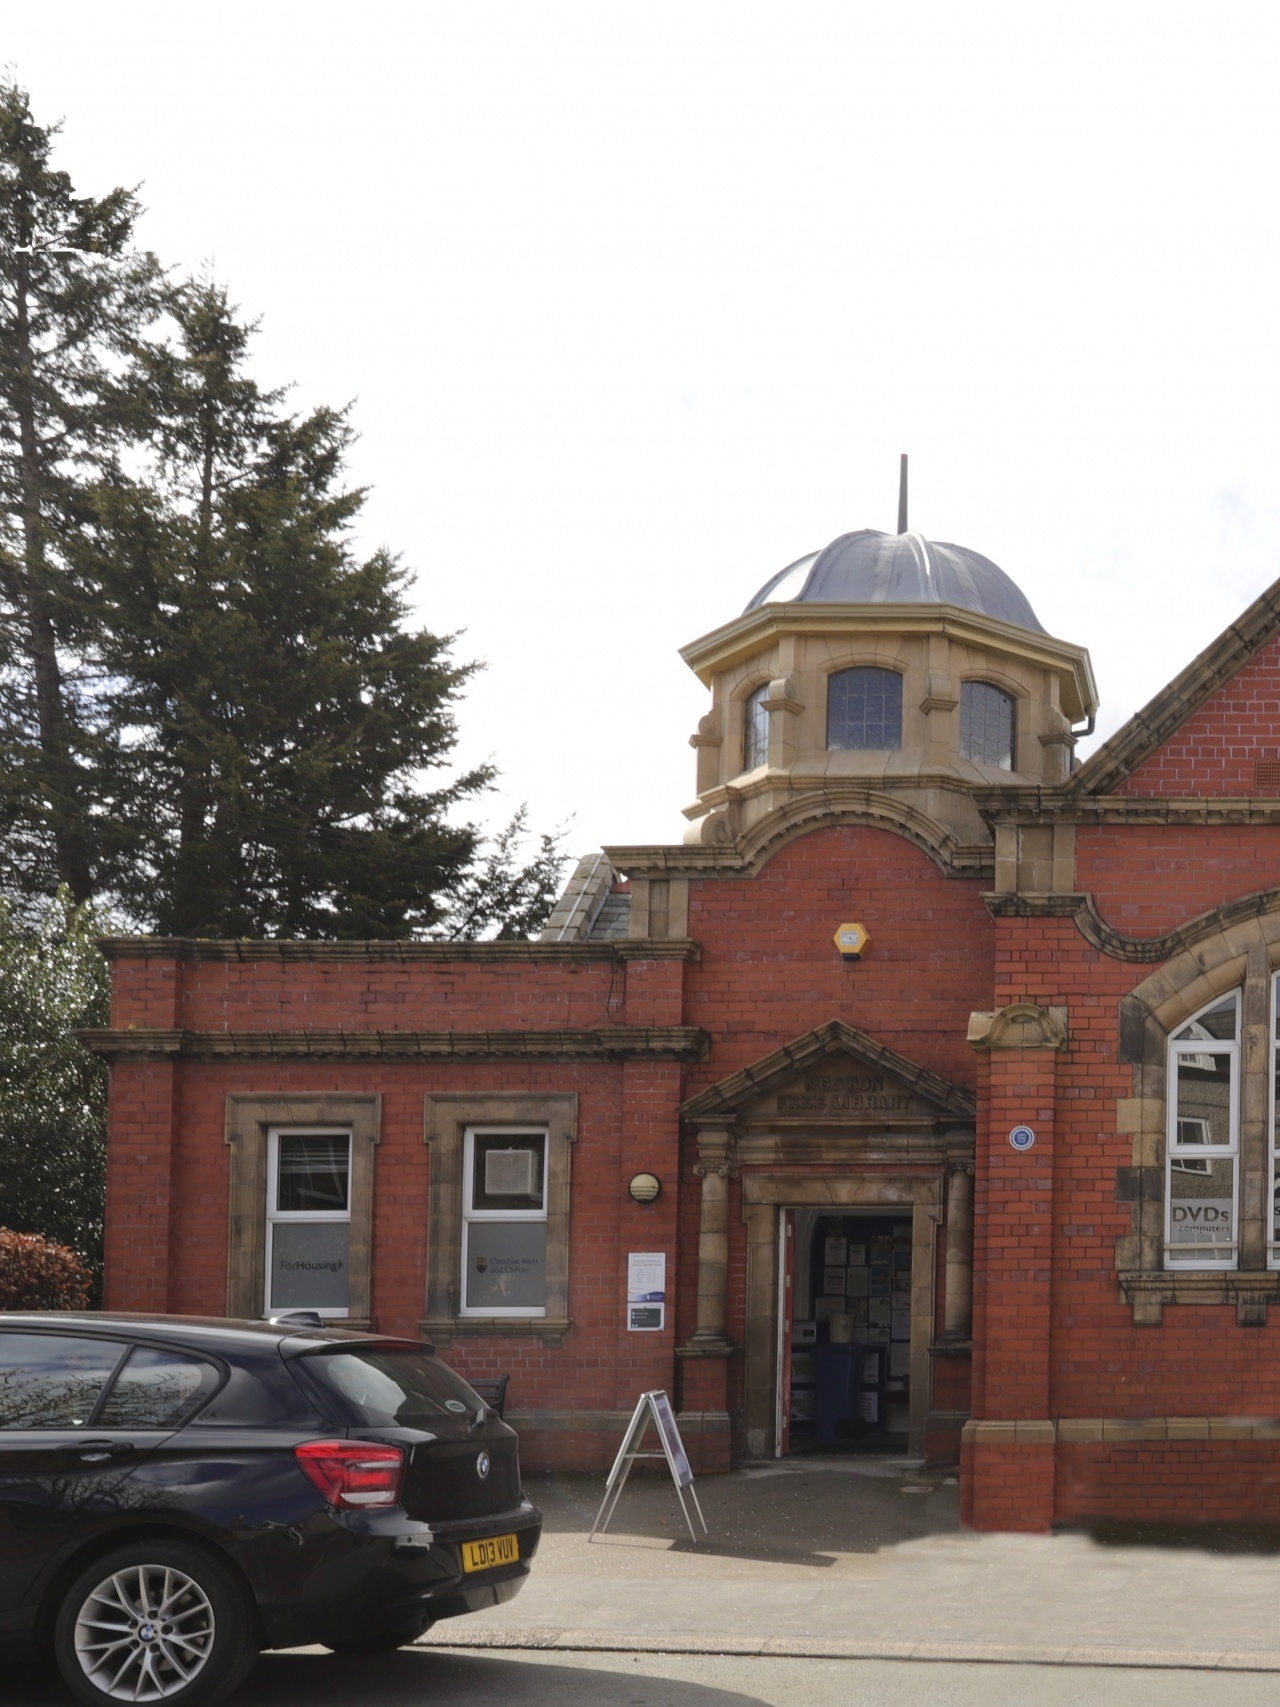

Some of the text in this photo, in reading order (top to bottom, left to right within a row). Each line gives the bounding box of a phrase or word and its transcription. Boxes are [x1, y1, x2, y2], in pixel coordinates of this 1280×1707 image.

[833, 1093, 912, 1110] LIBRARY
[1172, 1206, 1229, 1222] DVDs
[1179, 1225, 1231, 1234] computers
[280, 1260, 338, 1273] ForHousing
[470, 1541, 495, 1567] LD13
